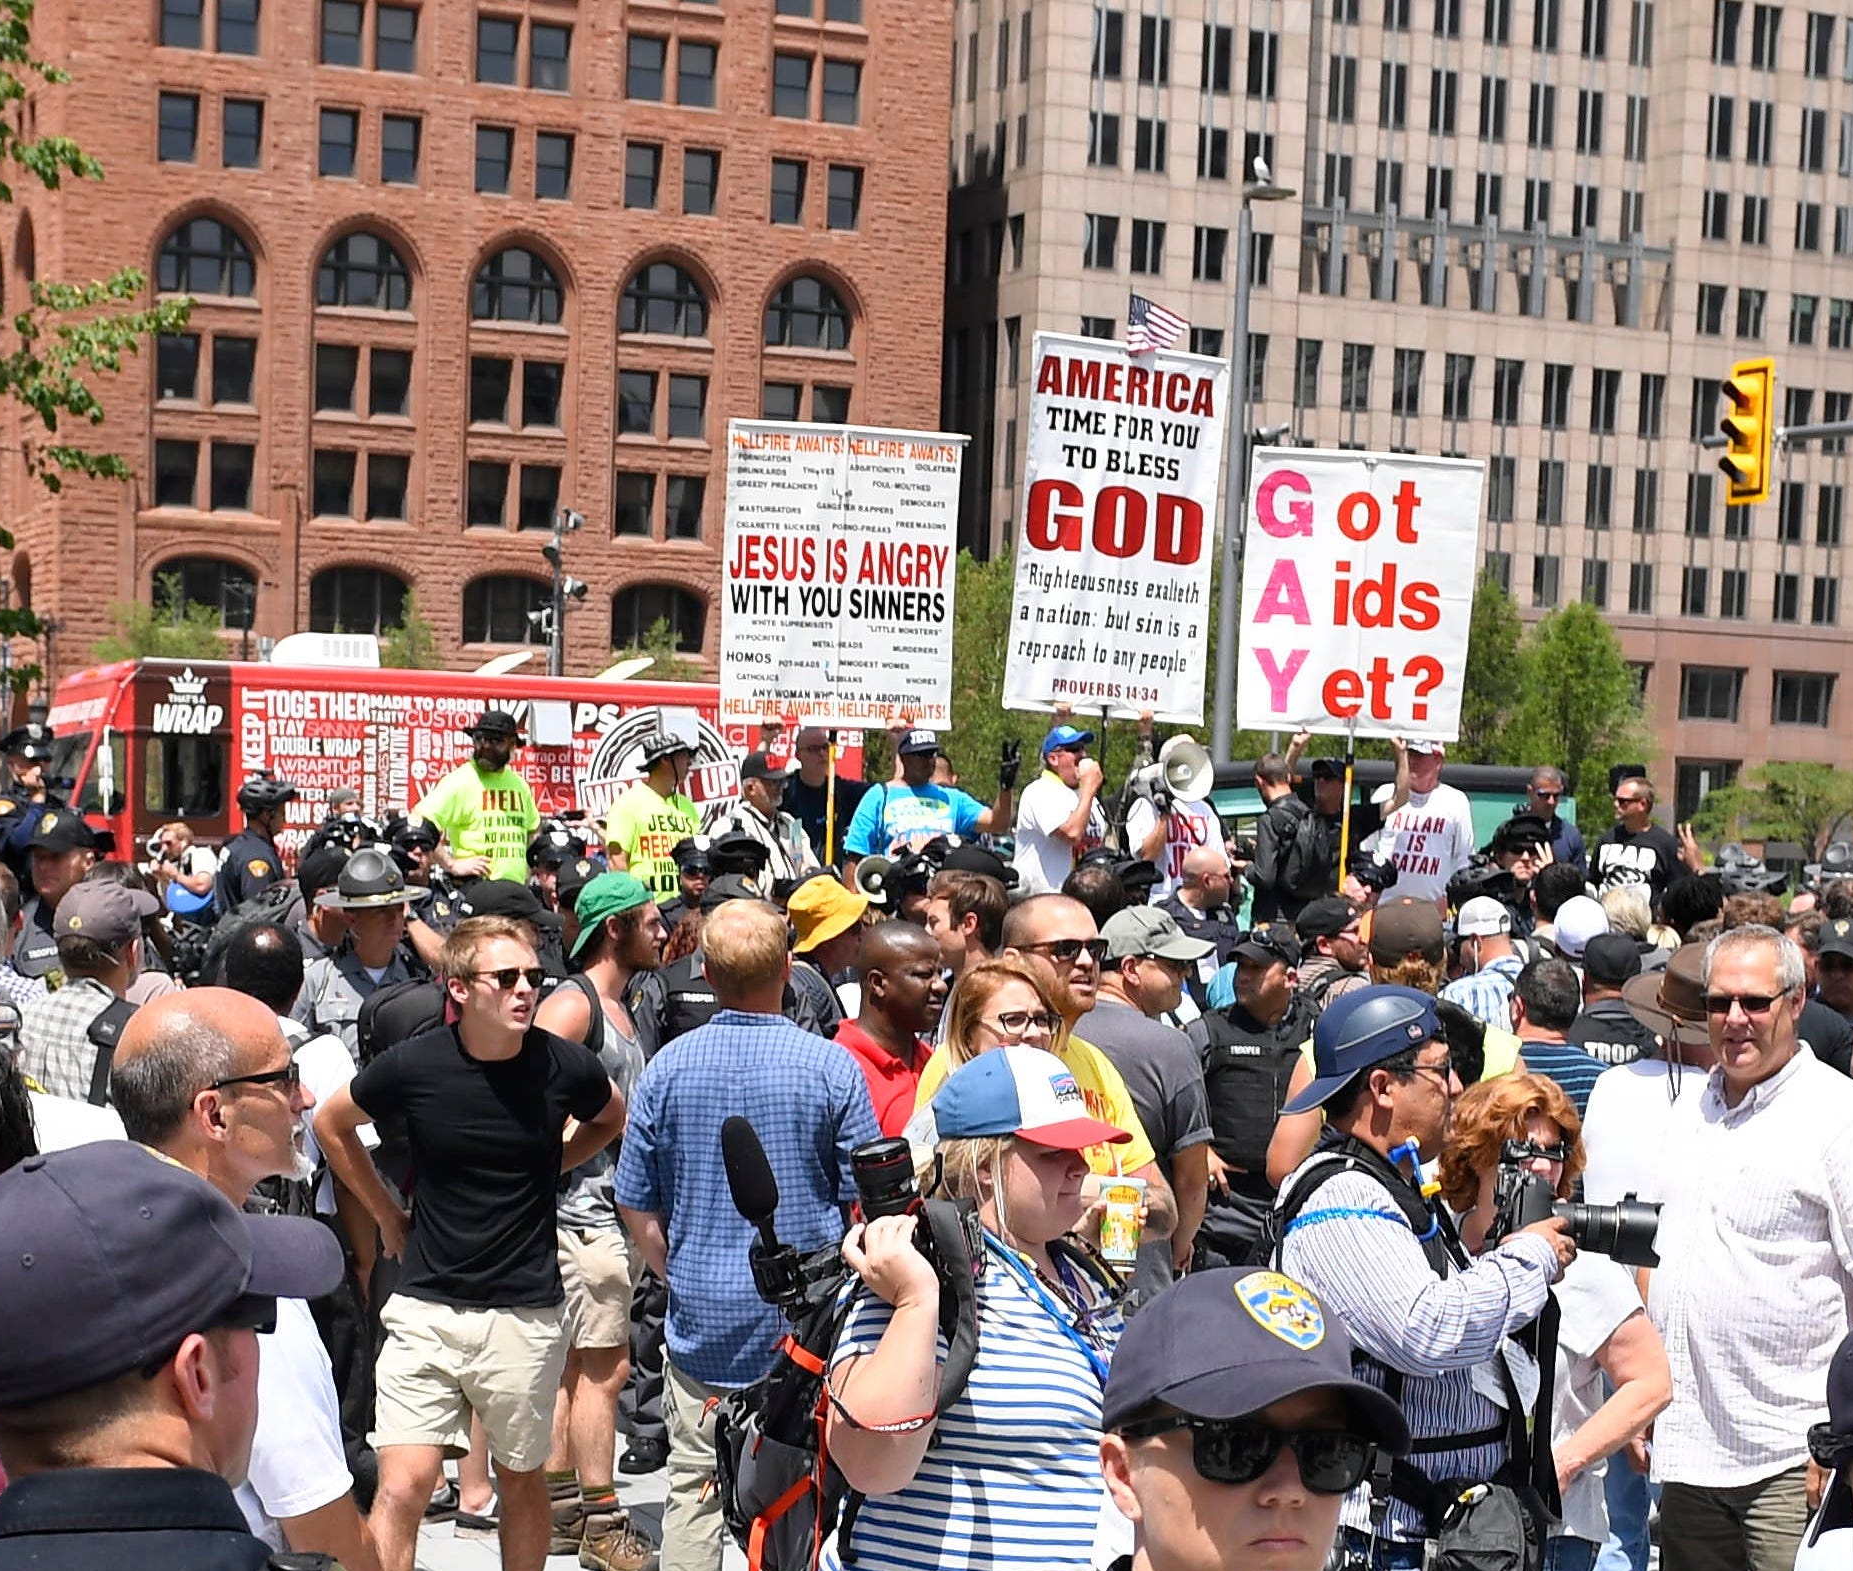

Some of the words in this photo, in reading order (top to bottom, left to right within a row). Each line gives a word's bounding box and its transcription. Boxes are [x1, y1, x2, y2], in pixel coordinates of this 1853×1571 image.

[1036, 355, 1214, 418] AMERICA
[1046, 406, 1106, 435] TIME
[1113, 413, 1153, 442] FOR
[1161, 422, 1200, 449] YOU
[848, 439, 905, 458] HELLFIRE
[909, 446, 957, 463] AWAITS!
[1062, 444, 1097, 469] TO
[1105, 449, 1180, 481] BLESS
[736, 480, 768, 489] GREEDY
[771, 481, 818, 491] PREACHERS
[738, 505, 802, 514] MASTURBATORS
[857, 505, 894, 515] RAPPERS
[900, 498, 946, 509] DEMOCRATS
[1026, 478, 1203, 565] GOD
[729, 534, 816, 582] JESUS
[826, 537, 848, 583] IS
[857, 541, 949, 588] ANGRY
[1145, 578, 1200, 604] exalteth
[730, 583, 789, 615] WITH
[798, 586, 842, 617] YOU
[849, 588, 945, 622] SINNERS
[1020, 605, 1029, 621] a
[1036, 603, 1098, 627] nation:
[1105, 605, 1130, 631] but
[1136, 612, 1163, 635] sin
[1168, 615, 1180, 638] is
[1187, 622, 1197, 639] a
[735, 634, 786, 643] HYPOCRITES
[726, 651, 772, 664] HOMOS
[1018, 638, 1085, 664] reproach
[1093, 642, 1107, 664] to
[1113, 649, 1136, 673] any
[736, 673, 779, 682] CATHOLICS
[906, 677, 937, 685] WHORES
[752, 689, 772, 699] ANY
[775, 690, 810, 699] WOMAN
[860, 693, 872, 701] AN
[876, 693, 921, 703] ABORTION
[1052, 678, 1121, 698] PROVERBS
[1126, 686, 1158, 702] 14:34
[265, 689, 371, 721] TOGETHER
[370, 694, 412, 711] MADE
[414, 696, 433, 711] TO
[436, 698, 485, 713] ORDER
[724, 699, 781, 716] HELLFIRE
[838, 703, 895, 718] HELLFIRE
[899, 704, 946, 719] AWAITS!
[153, 703, 223, 734] WRAP
[371, 710, 405, 722] TASTY
[267, 718, 305, 736] STAY
[306, 721, 361, 737] SKINNY
[241, 713, 266, 769] KEEP
[270, 737, 321, 756] DOUBLE
[323, 738, 361, 758] WRAP
[700, 764, 737, 799] UP
[649, 814, 694, 834] JESUS
[1393, 812, 1445, 834] ALLAH
[1407, 834, 1426, 852] IS
[1391, 853, 1440, 875] SATAN
[1230, 1045, 1261, 1055] TROOPER
[1584, 1041, 1639, 1064] TROO
